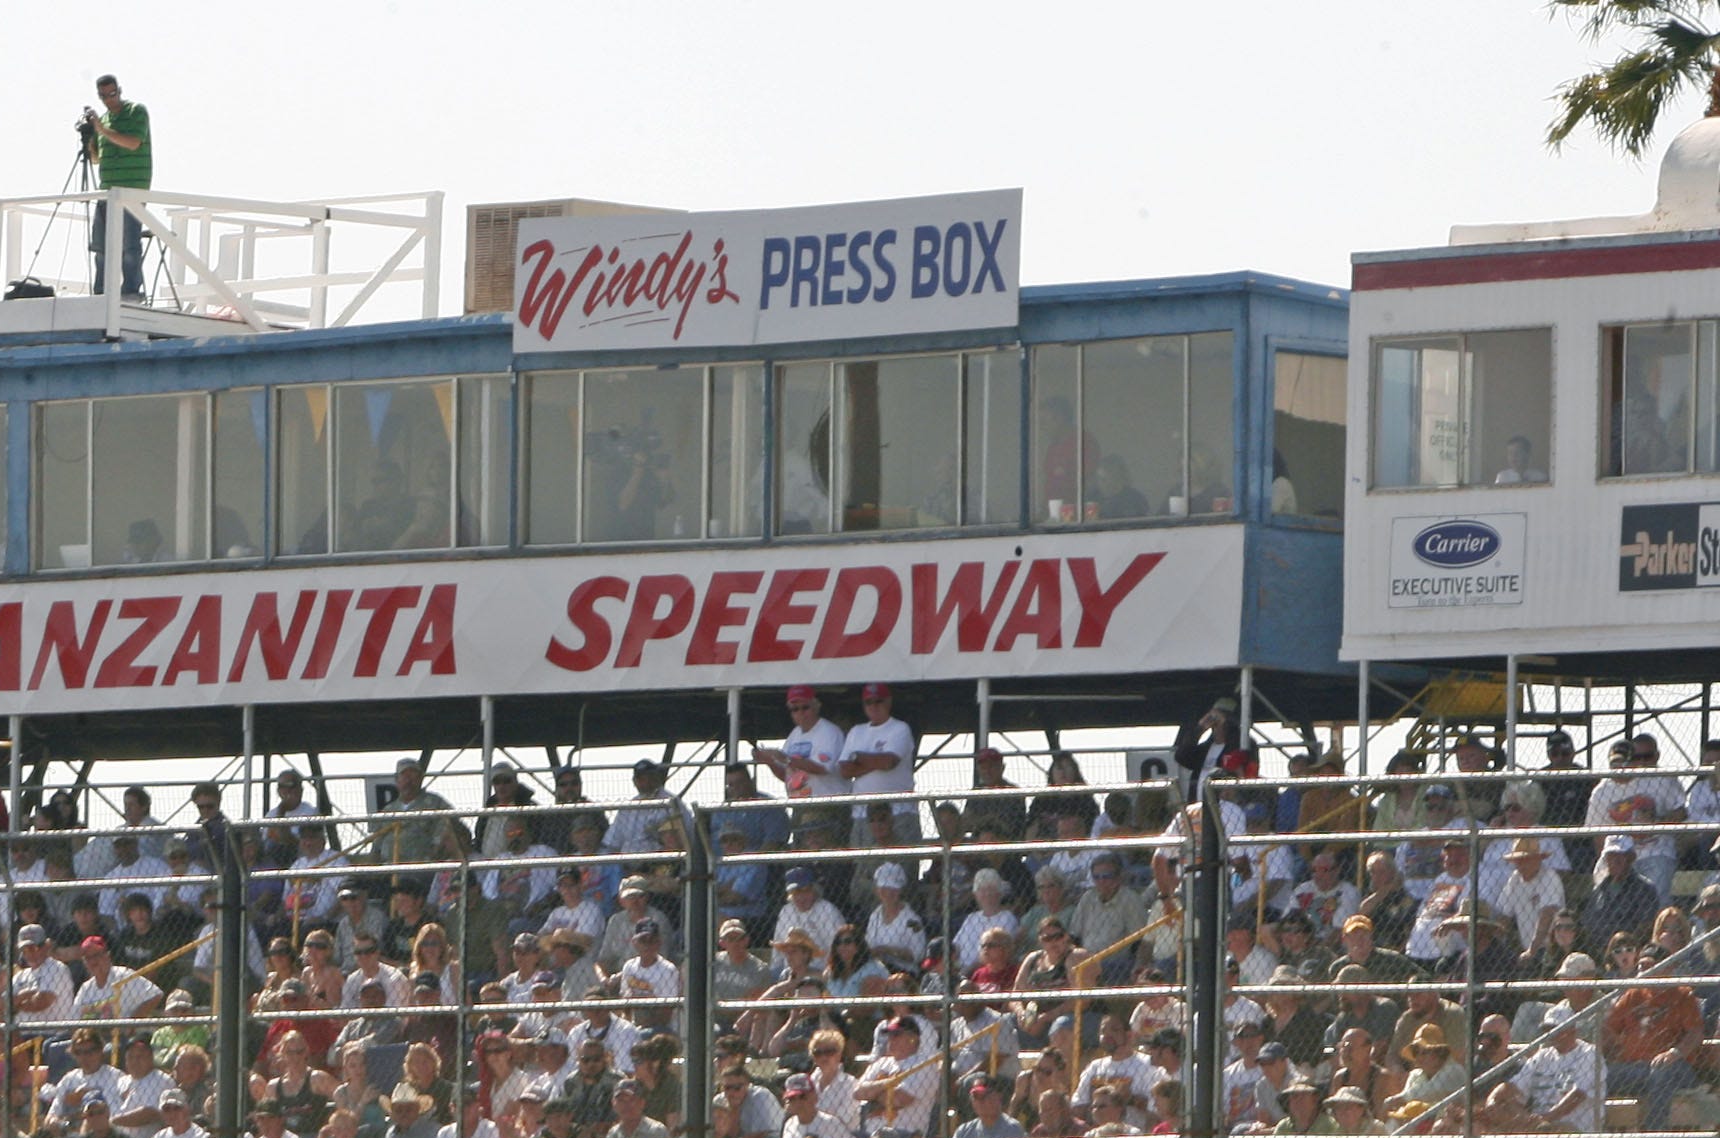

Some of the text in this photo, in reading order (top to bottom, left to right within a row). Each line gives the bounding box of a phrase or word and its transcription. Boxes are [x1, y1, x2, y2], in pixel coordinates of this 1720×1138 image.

[518, 218, 1008, 341] Windy's PRESS BOX
[1425, 533, 1490, 553] Carrier
[1633, 530, 1697, 577] Parker
[1392, 575, 1520, 596] EXECUTIVE SUITE
[545, 551, 1169, 672] SPEEDWAY
